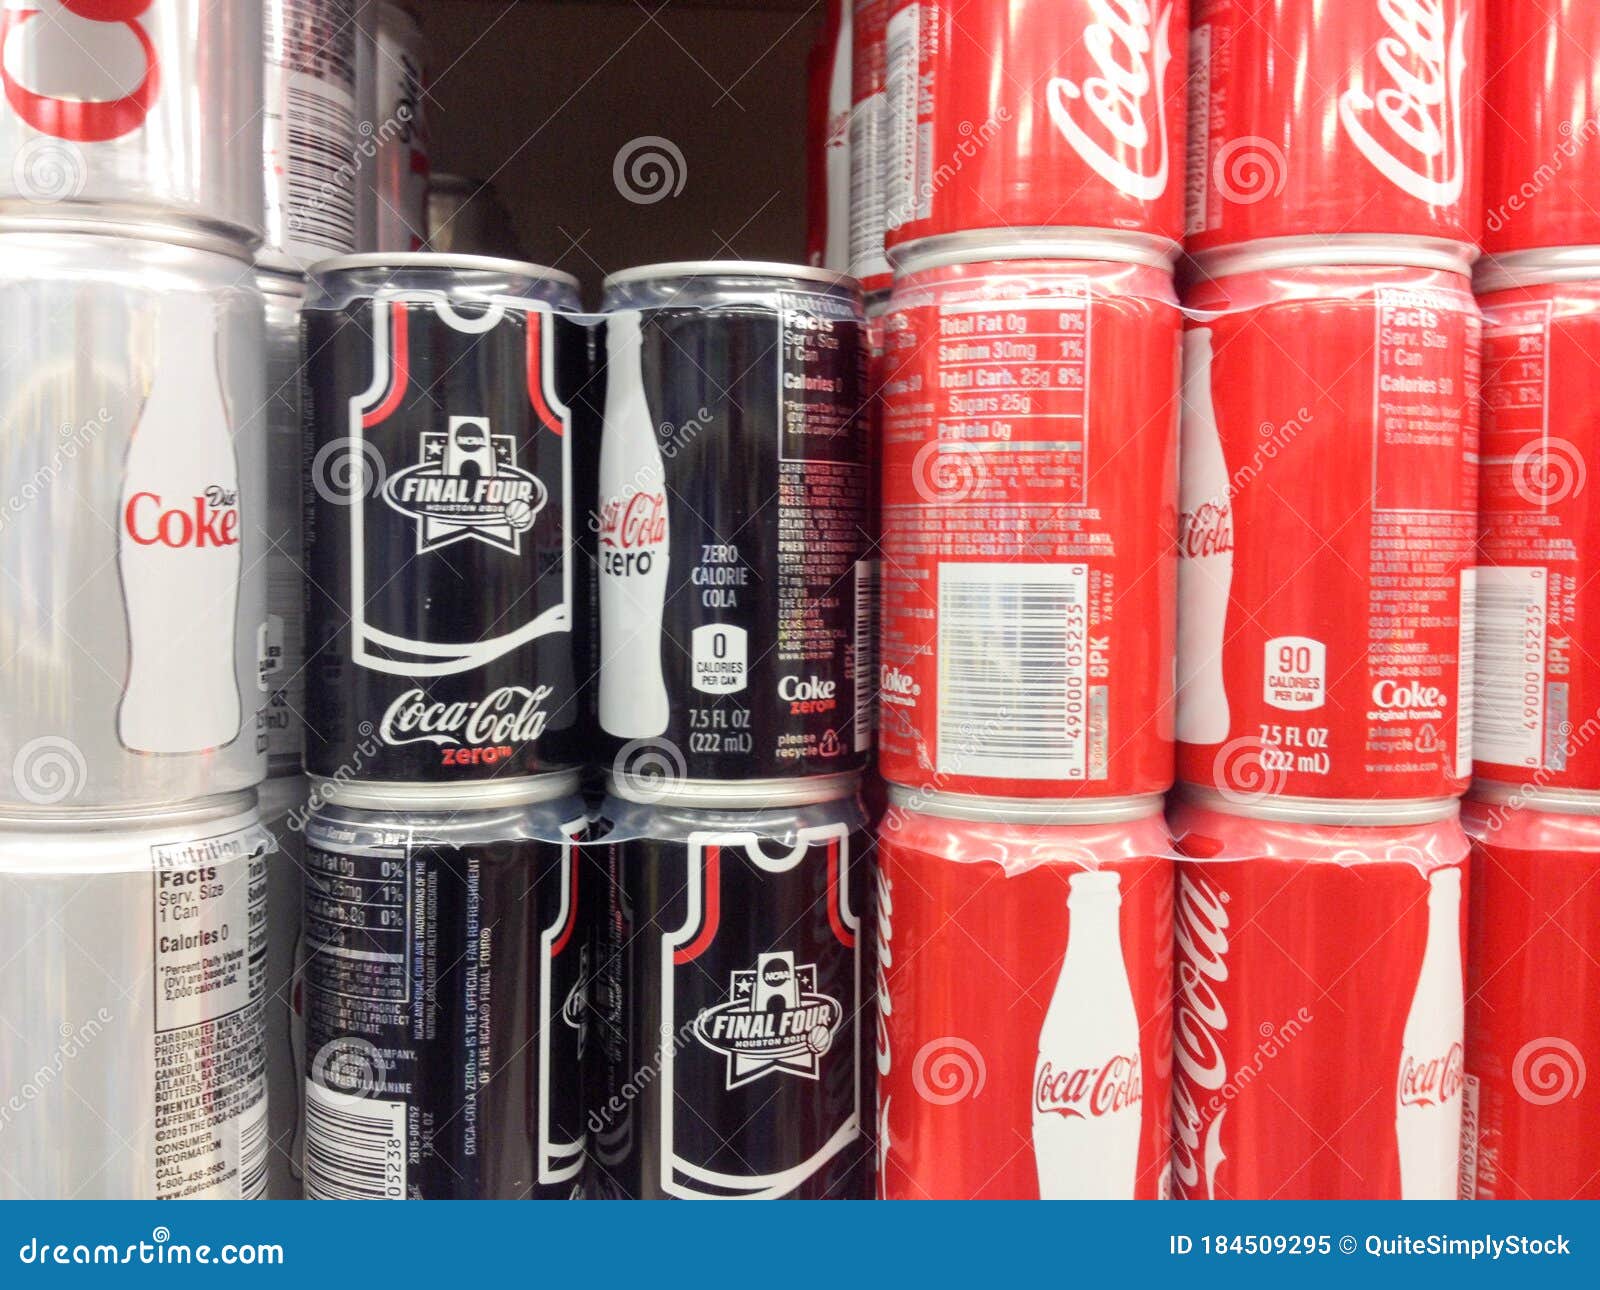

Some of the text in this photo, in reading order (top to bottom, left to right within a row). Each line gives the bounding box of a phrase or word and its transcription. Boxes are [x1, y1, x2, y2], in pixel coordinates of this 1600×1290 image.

[784, 311, 834, 332] Facts
[939, 314, 1027, 334] Total Fat 0g
[1381, 307, 1437, 328] Facts
[1381, 329, 1448, 348] Serv. Size
[794, 346, 818, 362] Can
[939, 341, 1083, 362] Sodium 30mg 1%
[1394, 350, 1423, 366] Can
[784, 372, 833, 392] Calories
[939, 368, 1050, 388] Total Carb. 25g
[1380, 375, 1437, 394] Calories
[949, 394, 1031, 415] Sugars 25g
[938, 422, 1011, 440] Protein 0g
[402, 479, 532, 503] FINAL FOUR
[125, 492, 239, 548] Coke
[702, 545, 738, 563] ZERO
[692, 567, 748, 585] CALORIE
[1072, 567, 1083, 575] 0
[702, 589, 737, 608] COLA
[1066, 604, 1083, 666] 05235
[1525, 605, 1541, 663] 05235
[713, 633, 726, 659] 0
[1548, 635, 1570, 674] 8PK
[1089, 636, 1109, 677] 8PK
[1279, 646, 1311, 673] 90
[696, 662, 743, 673] CALORIES
[702, 676, 737, 685] PER CAN
[778, 675, 836, 700] Coke
[1269, 675, 1320, 690] CALORIES
[1275, 690, 1314, 702] PER CAN
[1524, 672, 1539, 729] 49000
[380, 685, 553, 745] Coca-Cola
[1066, 676, 1082, 739] 49000
[1366, 710, 1408, 722] original
[689, 710, 750, 727] 7.5 FL OZ
[689, 732, 720, 752] (222
[778, 733, 816, 746] please
[1259, 724, 1328, 748] 7.5 FL OZ
[1368, 727, 1411, 738] please
[776, 745, 817, 759] recycle
[1365, 739, 1413, 753] recycle
[1070, 767, 1081, 776] 0
[1259, 749, 1330, 775] (222 mL)
[158, 839, 241, 868] Nutrition
[160, 867, 216, 888] Facts
[381, 861, 404, 878] 0%
[415, 861, 426, 875] THE
[415, 877, 426, 886] OF
[160, 884, 224, 906] Serv. Size
[382, 886, 404, 902] 1%
[173, 905, 199, 920] Can
[381, 910, 404, 926] 0%
[415, 888, 426, 939] TRADEMARKS
[160, 924, 228, 953] Calories 0
[415, 941, 425, 955] ARE
[427, 922, 437, 956] ATHLETIC
[415, 957, 425, 977] FOUR
[480, 970, 491, 1000] FINAL
[415, 1001, 425, 1017] AND
[465, 858, 480, 1155] COCA-COLA IS THE OFFICIAL FAN REFRESHMENT
[415, 1018, 425, 1040] NCAA
[427, 1004, 437, 1040] NATIONAL
[712, 1004, 831, 1039] FINAL FOUR
[154, 1024, 215, 1046] CARBONATED
[735, 1037, 780, 1047] HOUSTON
[155, 1034, 214, 1057] PHOSPHORIC
[479, 1046, 490, 1066] THE
[155, 1063, 192, 1081] CANNED
[479, 1068, 490, 1083] OF
[1036, 1054, 1142, 1120] Coca-Cola
[155, 1110, 195, 1128] CAFFEINE
[190, 1119, 206, 1133] THE
[155, 1132, 212, 1155] CONSUMER
[155, 1139, 221, 1167] INFORMATION
[155, 1165, 183, 1179] CALL
[386, 1139, 401, 1196] 05238
